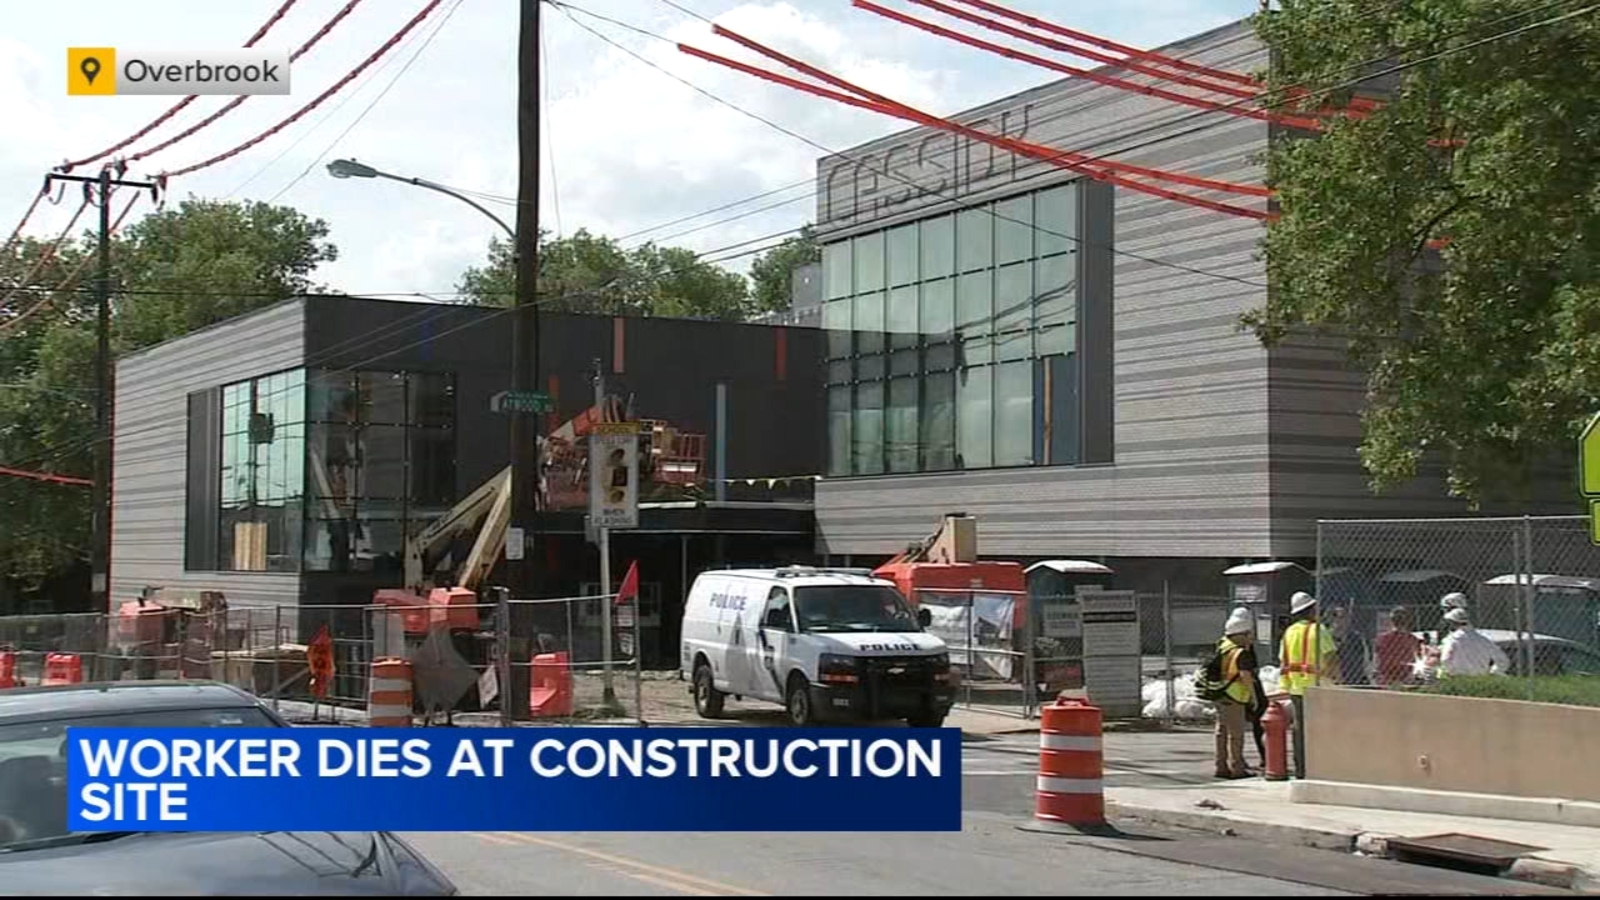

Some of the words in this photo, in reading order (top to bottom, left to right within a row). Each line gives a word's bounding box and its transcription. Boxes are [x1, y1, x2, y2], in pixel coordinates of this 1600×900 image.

[826, 103, 1034, 221] CASSIDY
[710, 592, 748, 612] POLICE
[859, 643, 922, 652] POLICE
